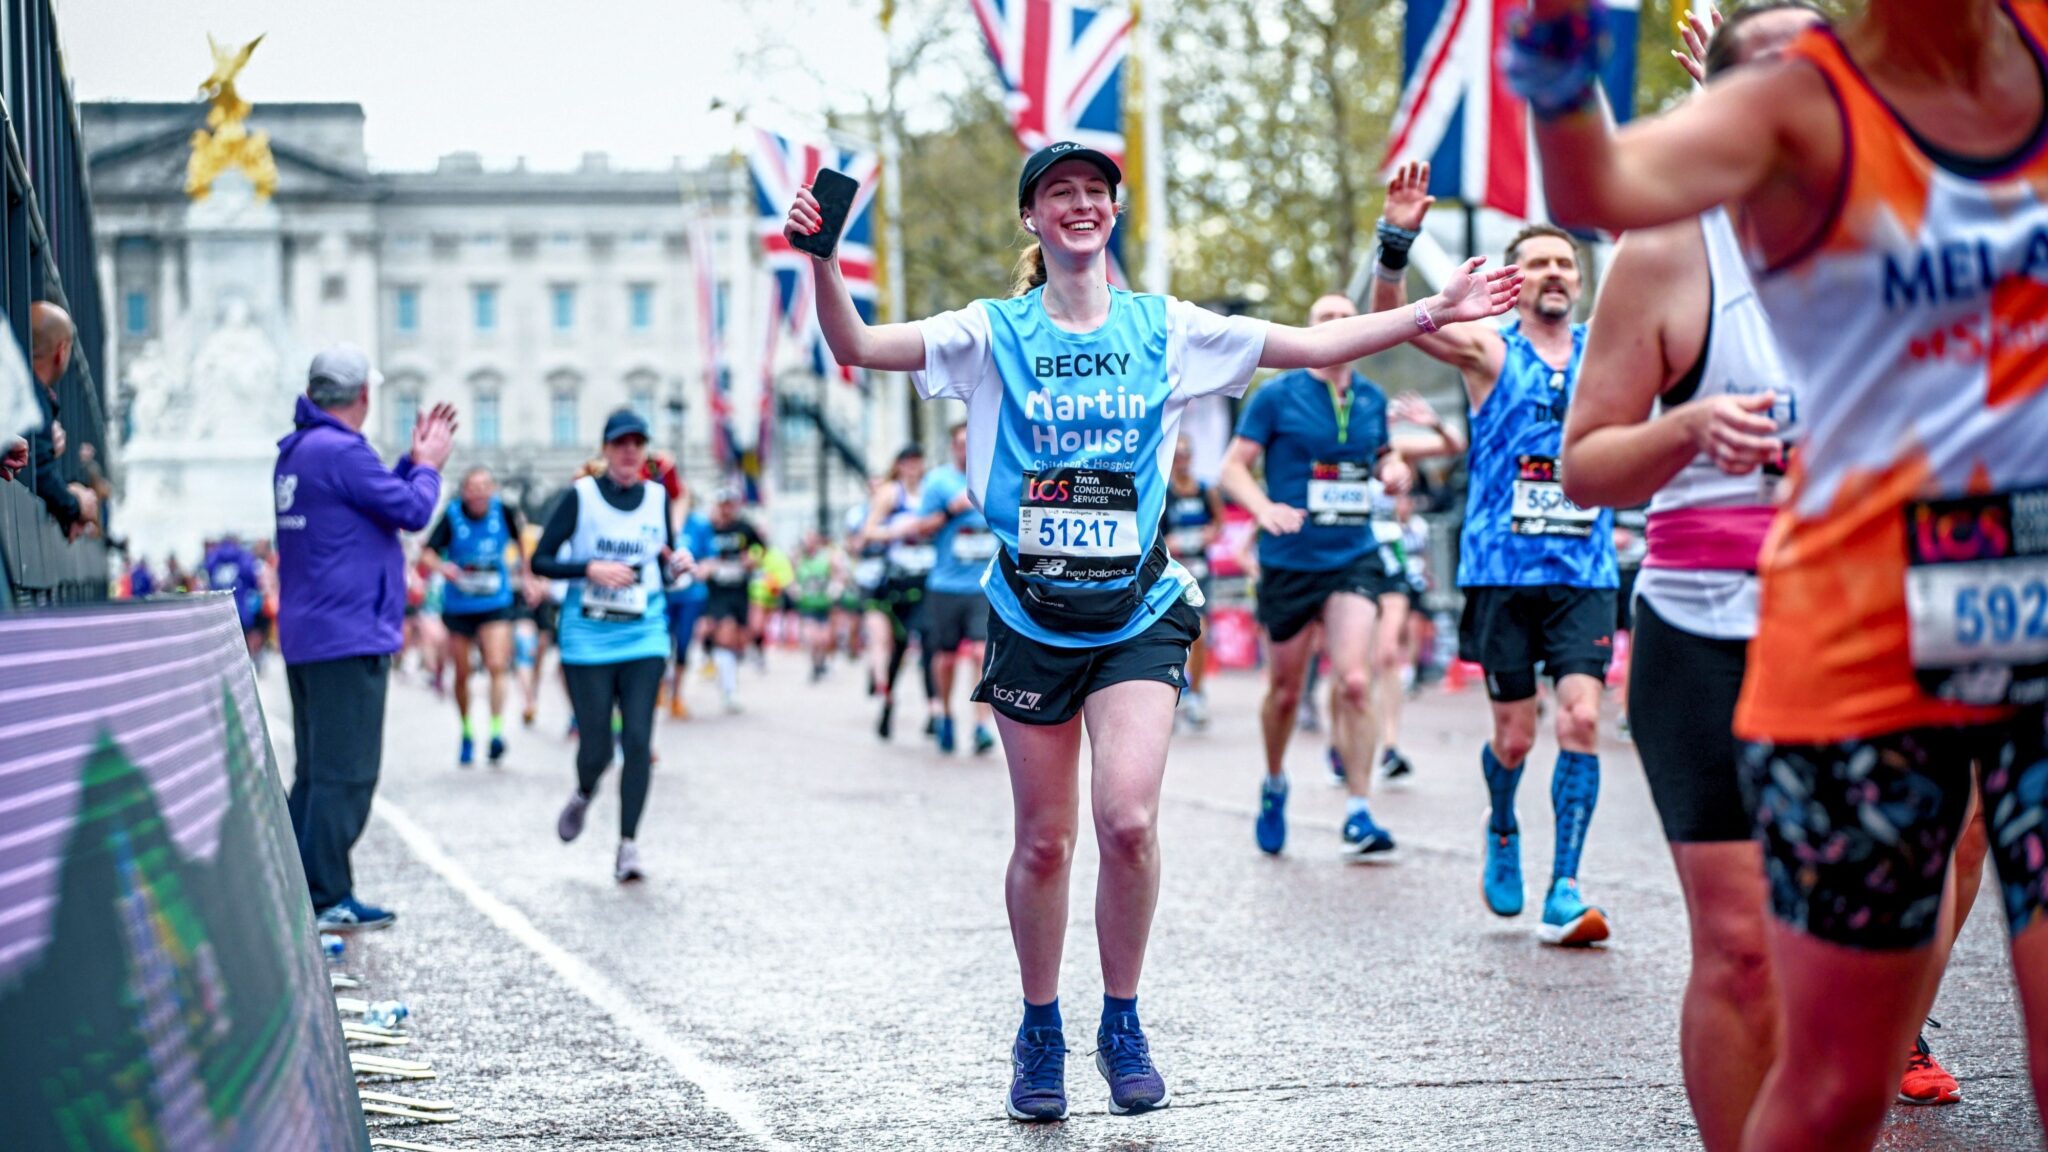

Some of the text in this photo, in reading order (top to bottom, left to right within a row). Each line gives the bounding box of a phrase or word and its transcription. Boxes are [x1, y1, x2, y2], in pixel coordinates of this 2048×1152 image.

[1035, 353, 1130, 378] BECKY
[1025, 386, 1146, 420] Martin
[1032, 424, 1140, 454] House
[1028, 478, 1070, 502] tcs
[1073, 485, 1132, 497] CONSULTANCY
[1074, 475, 1100, 485] TATA
[1072, 494, 1109, 504] SERVICES
[1039, 518, 1118, 548] 51217
[1066, 567, 1129, 578] new balance
